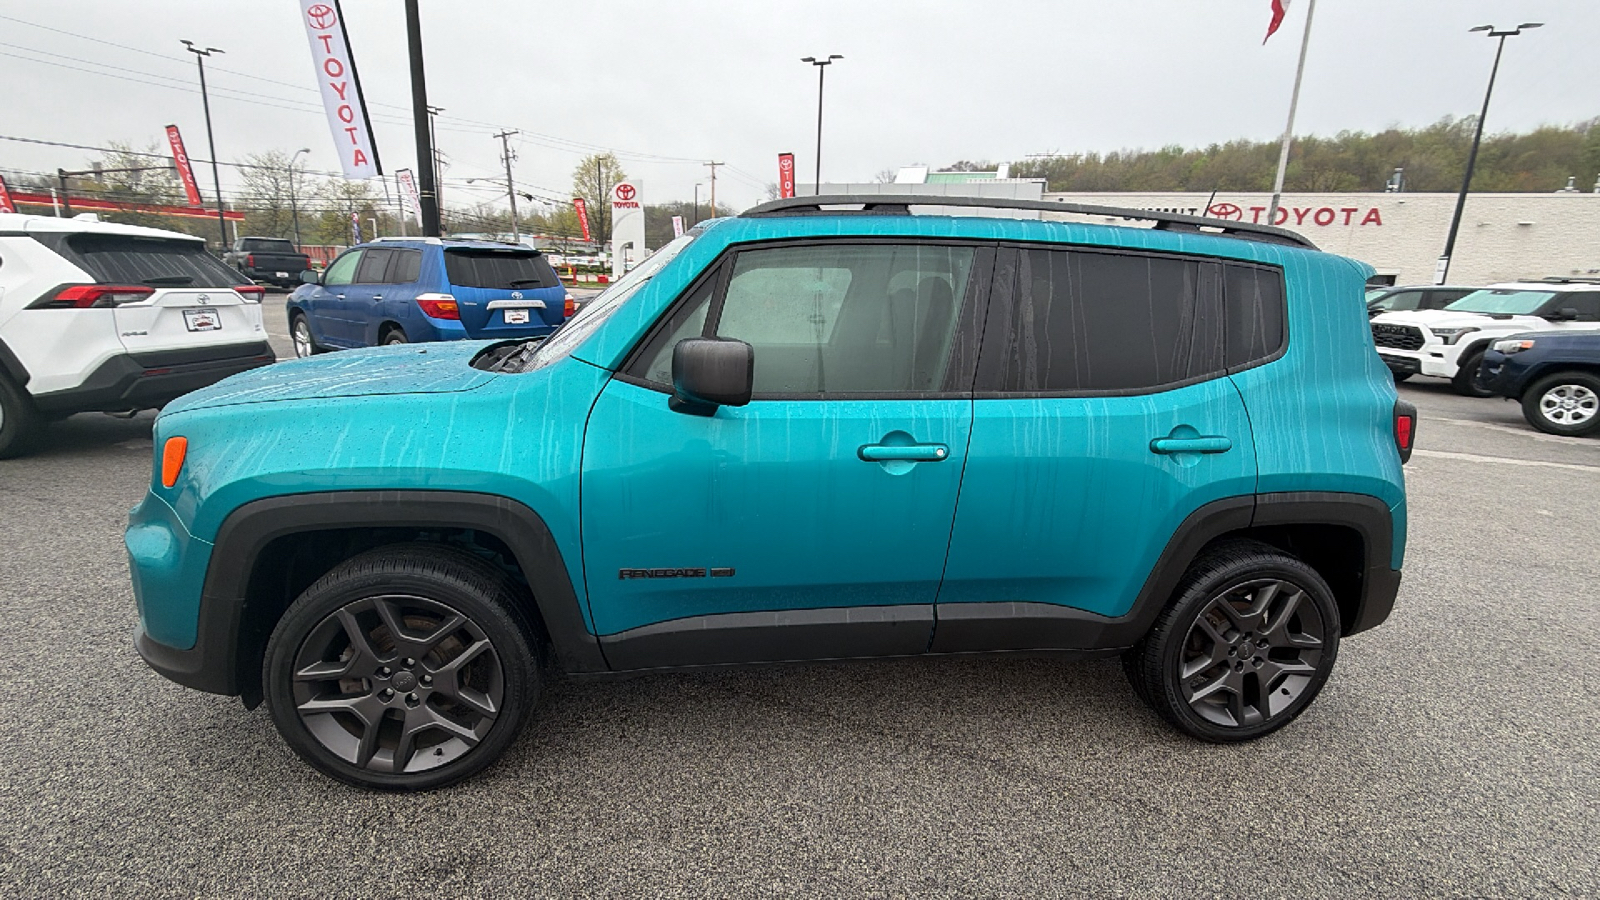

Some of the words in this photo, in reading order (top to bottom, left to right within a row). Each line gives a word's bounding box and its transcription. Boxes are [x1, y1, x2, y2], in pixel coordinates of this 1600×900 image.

[318, 35, 368, 167] TOYOTA
[784, 171, 792, 198] TOY
[612, 201, 640, 209] TOYOTA
[1249, 206, 1383, 226] TOYOTA
[618, 567, 706, 580] RENEGADE
